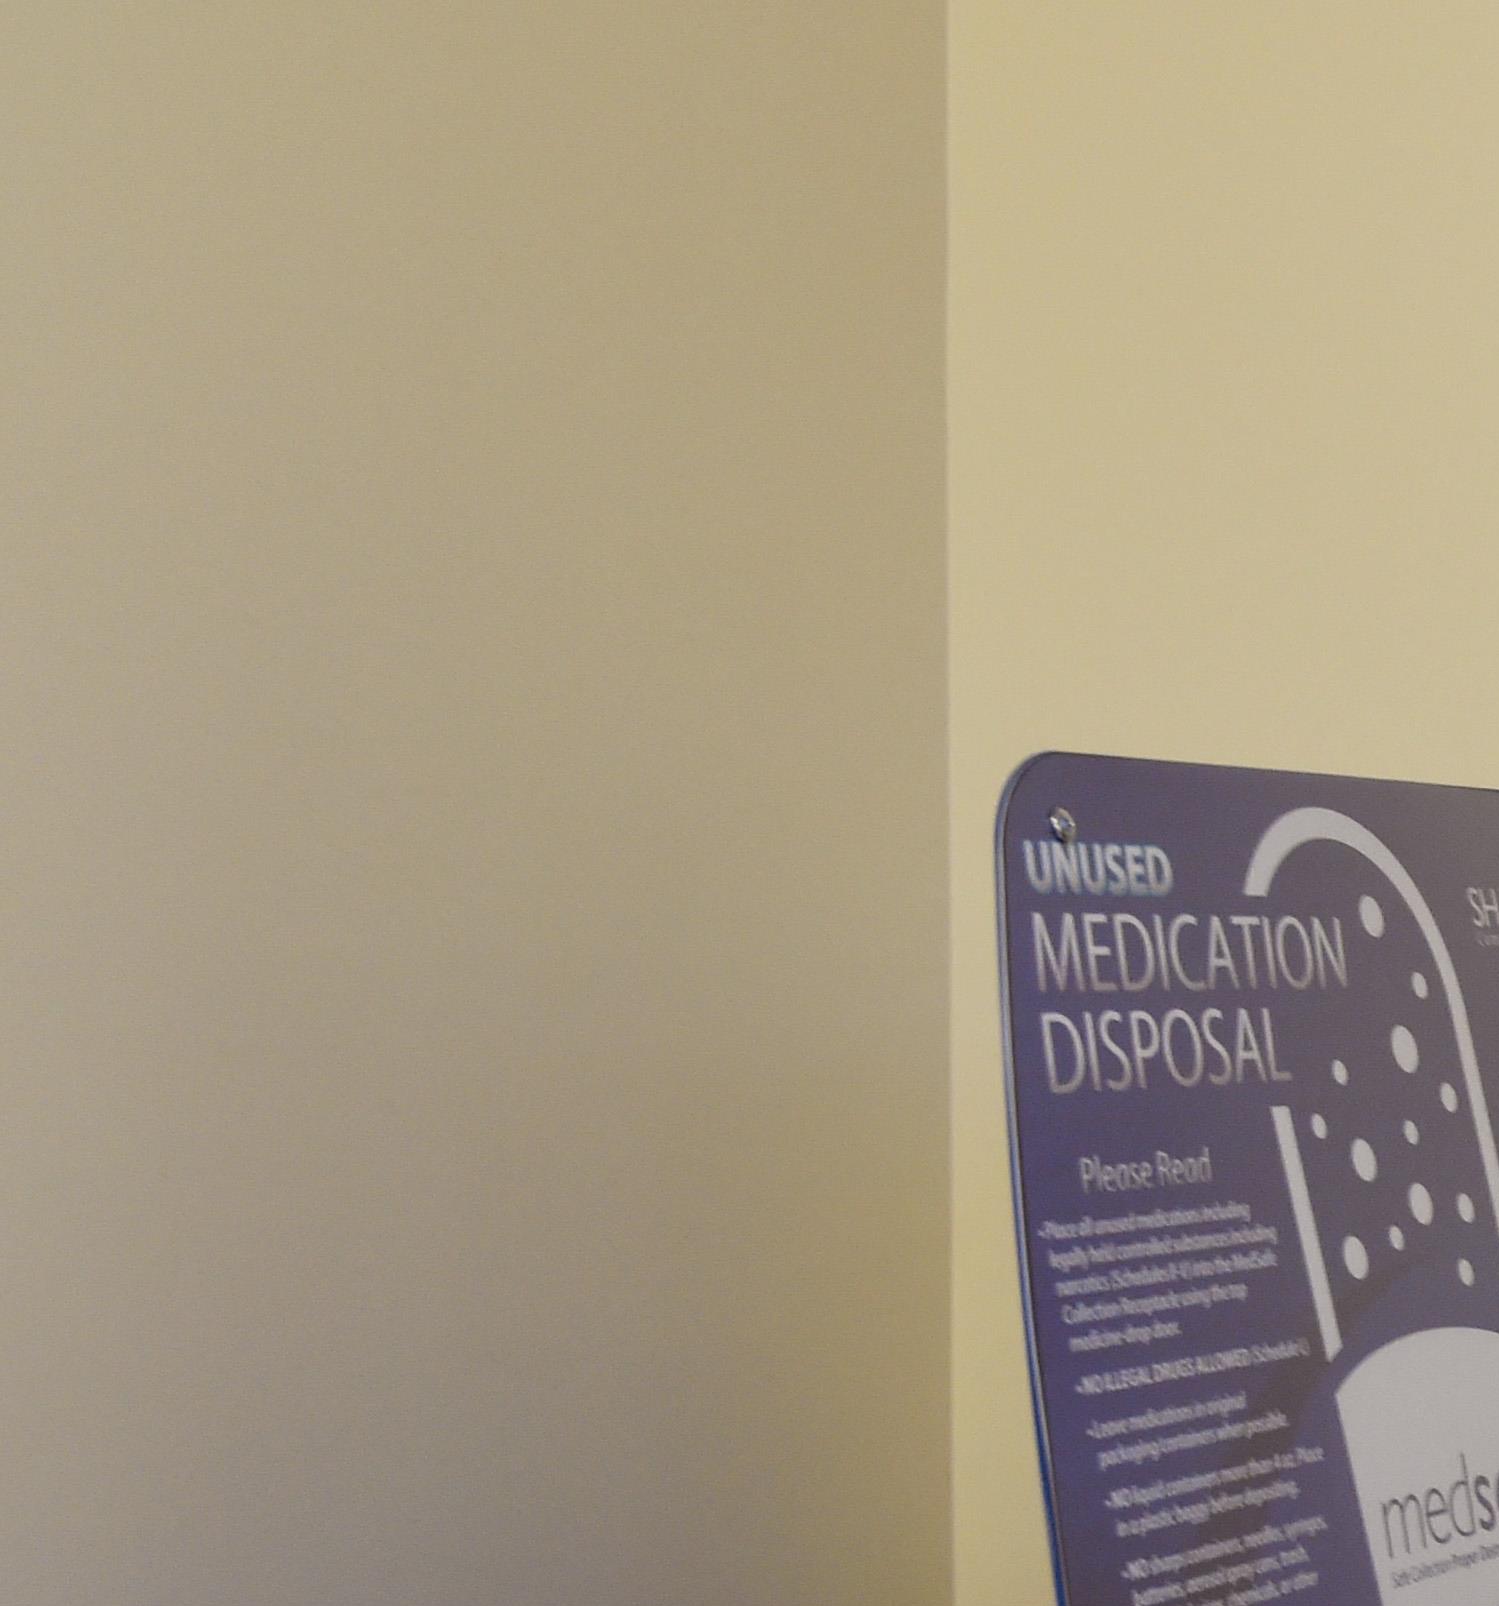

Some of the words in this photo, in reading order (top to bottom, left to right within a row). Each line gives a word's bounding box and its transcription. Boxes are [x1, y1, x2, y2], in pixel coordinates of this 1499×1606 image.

[1023, 840, 1173, 896] UNUSED
[1031, 911, 1348, 993] MEDICATION
[1041, 1006, 1292, 1094] DISPOSAL
[1079, 1154, 1153, 1194] Please
[1155, 1147, 1213, 1187] Read
